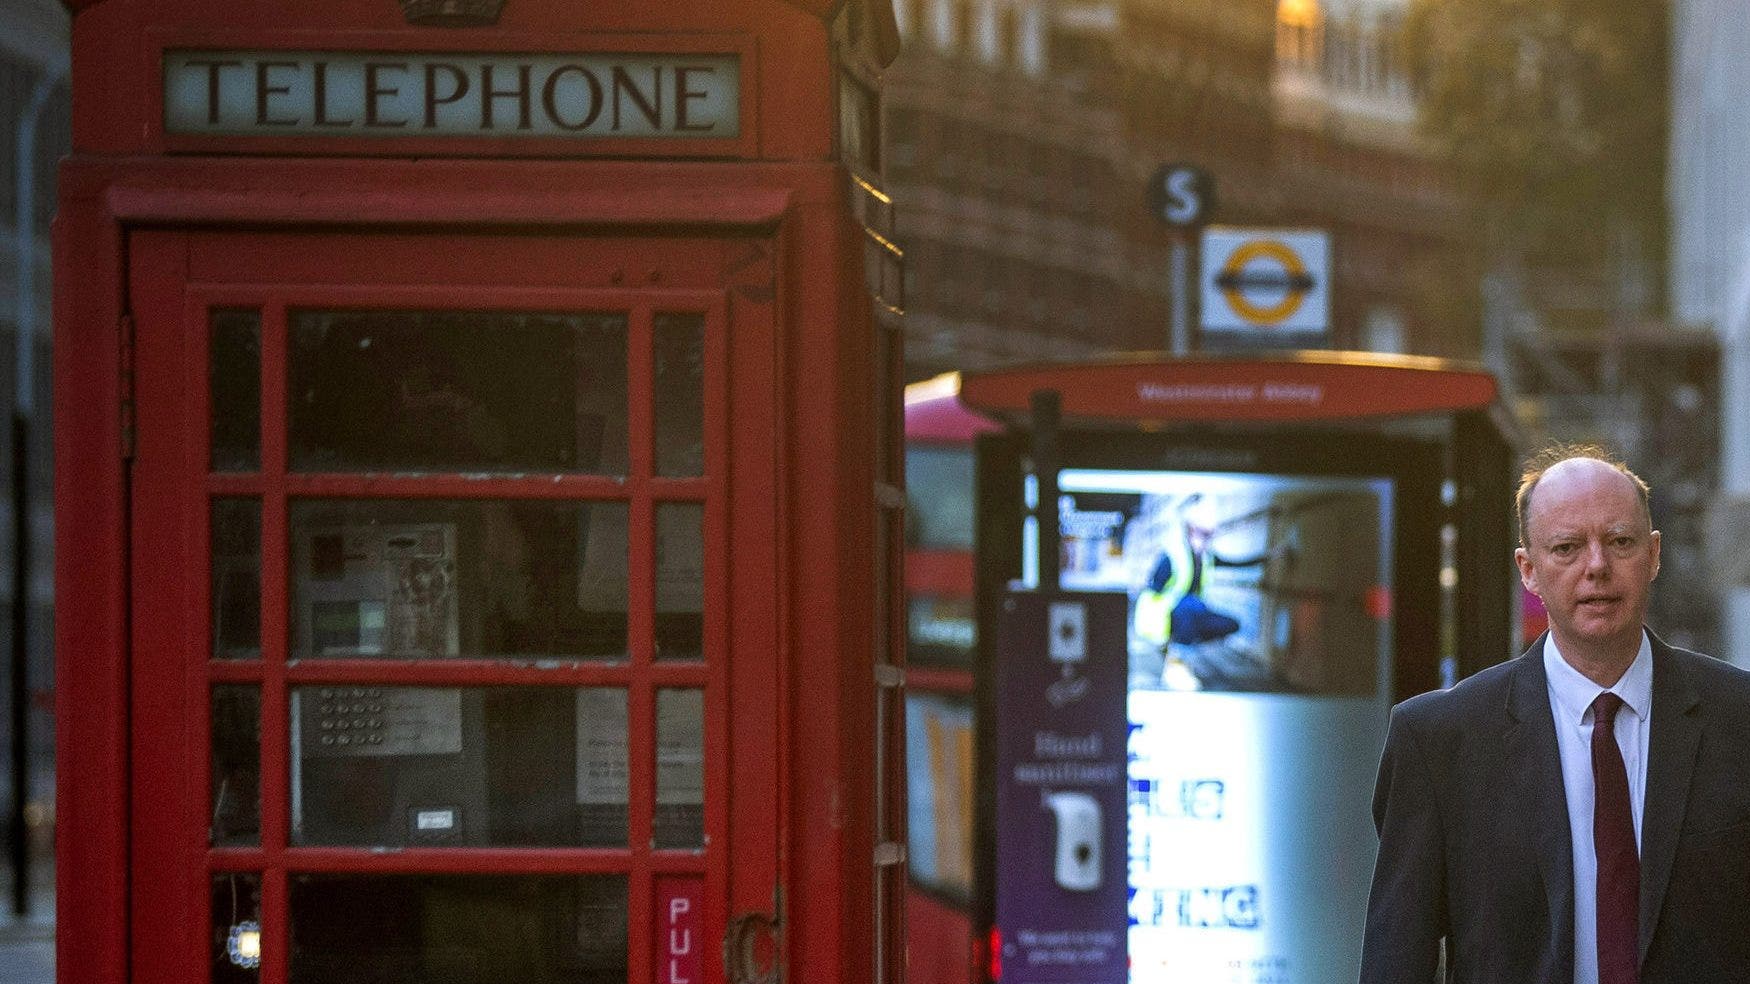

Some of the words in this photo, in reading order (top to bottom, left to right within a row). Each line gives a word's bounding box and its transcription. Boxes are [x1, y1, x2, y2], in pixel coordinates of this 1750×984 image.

[184, 60, 717, 132] TELEPHONE
[1165, 169, 1198, 225] S
[1138, 383, 1254, 401] Westminster
[1263, 383, 1320, 404] Abbey
[1035, 733, 1101, 757] Hand
